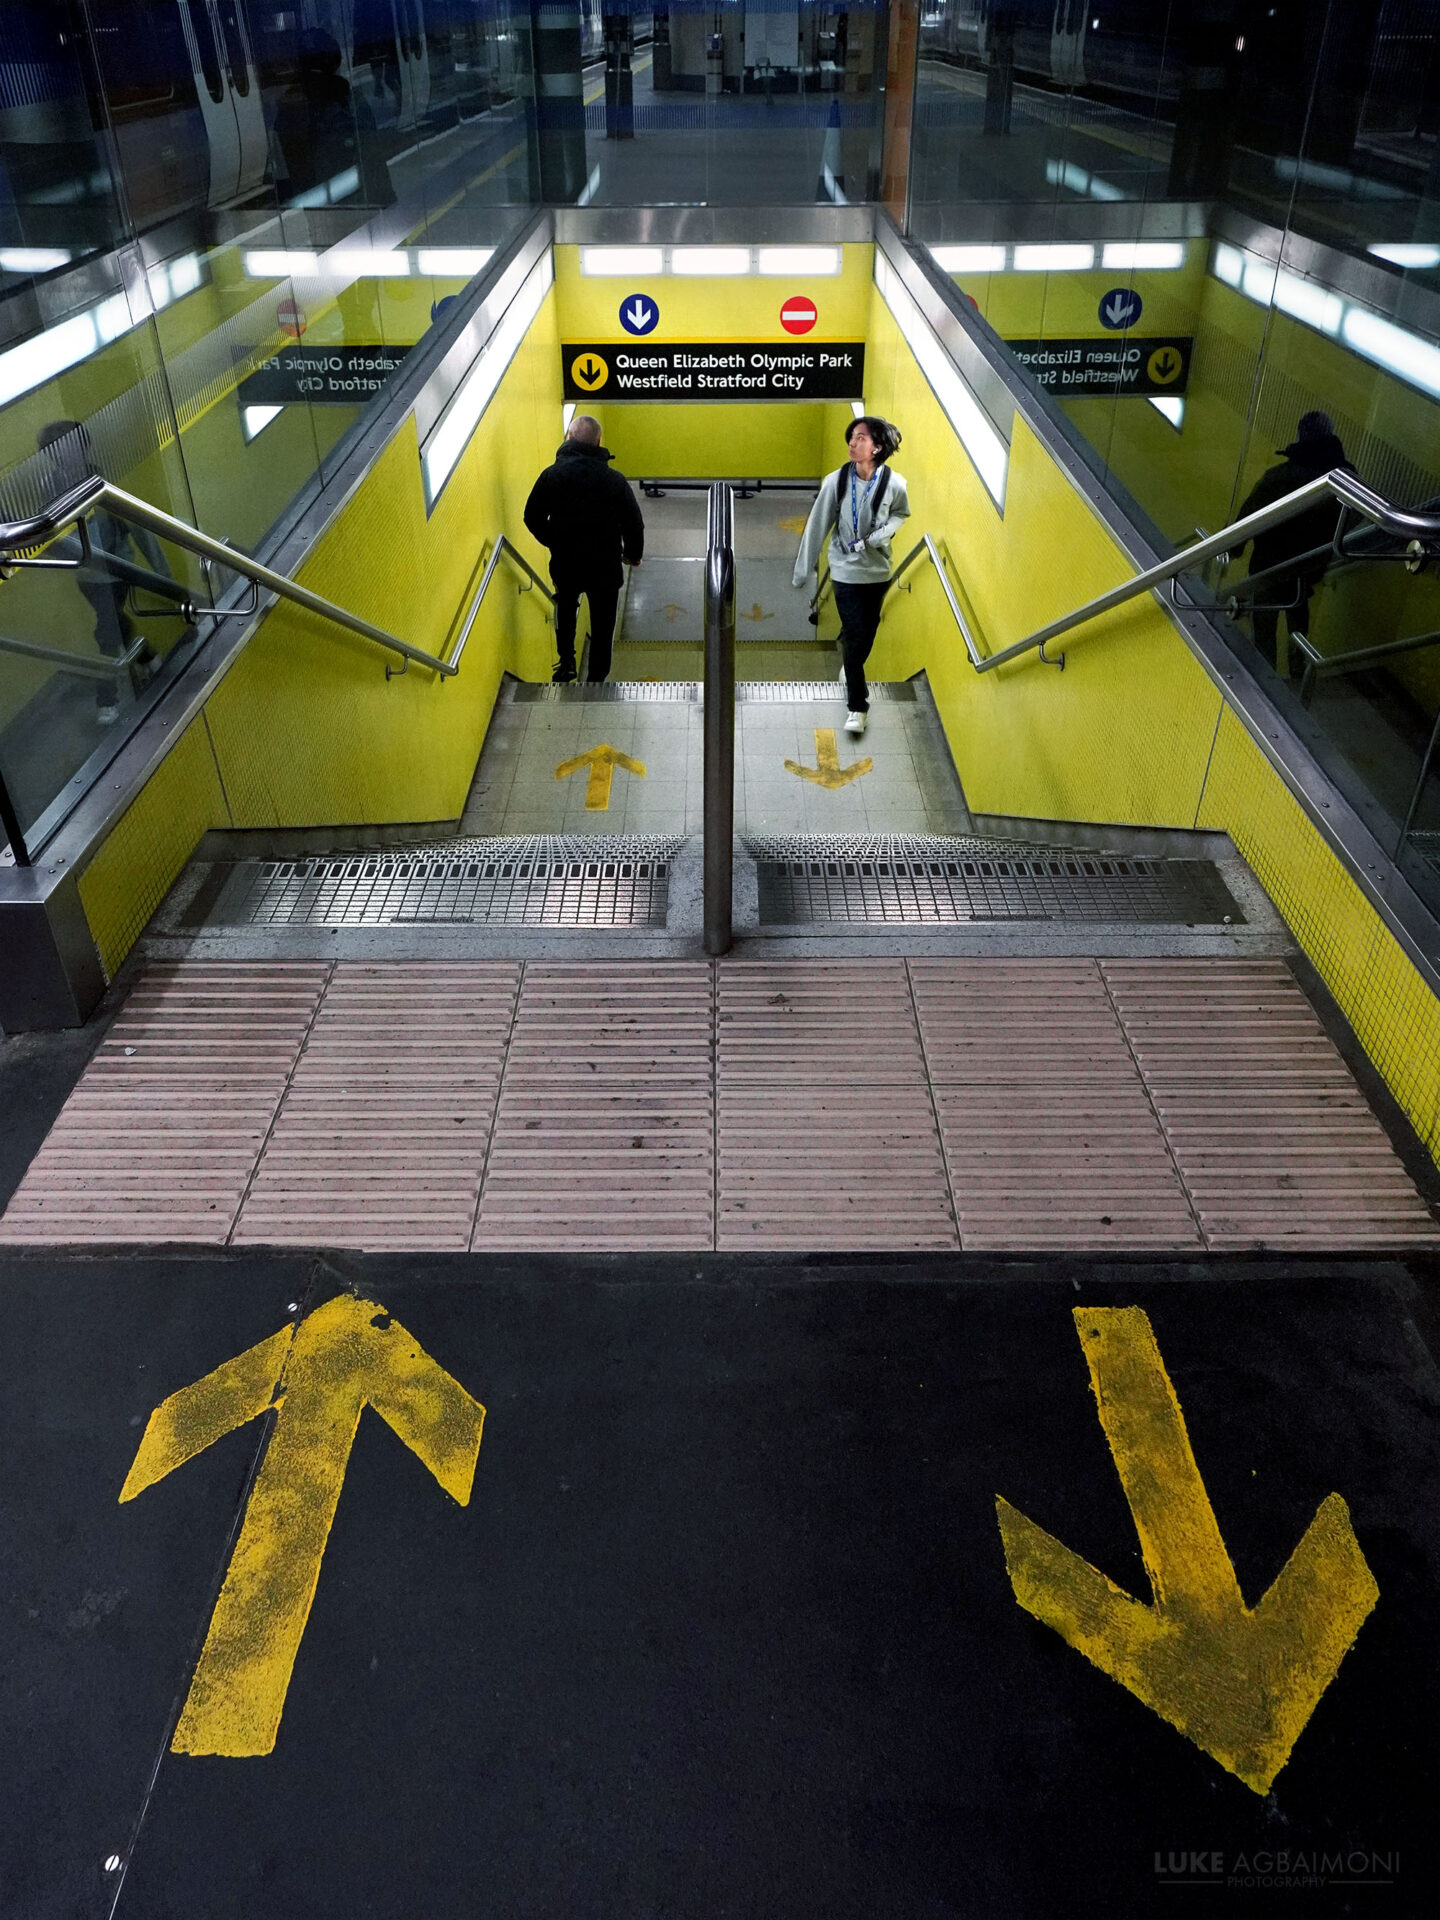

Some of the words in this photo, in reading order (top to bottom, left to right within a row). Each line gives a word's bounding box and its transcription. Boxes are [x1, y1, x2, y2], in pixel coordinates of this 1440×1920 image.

[616, 354, 668, 368] Queen
[673, 353, 745, 368] Elizabeth
[750, 353, 814, 371] Olympic
[819, 353, 853, 368] Park
[616, 375, 692, 388] Westfield
[697, 374, 766, 388] Stratford
[771, 374, 804, 390] City
